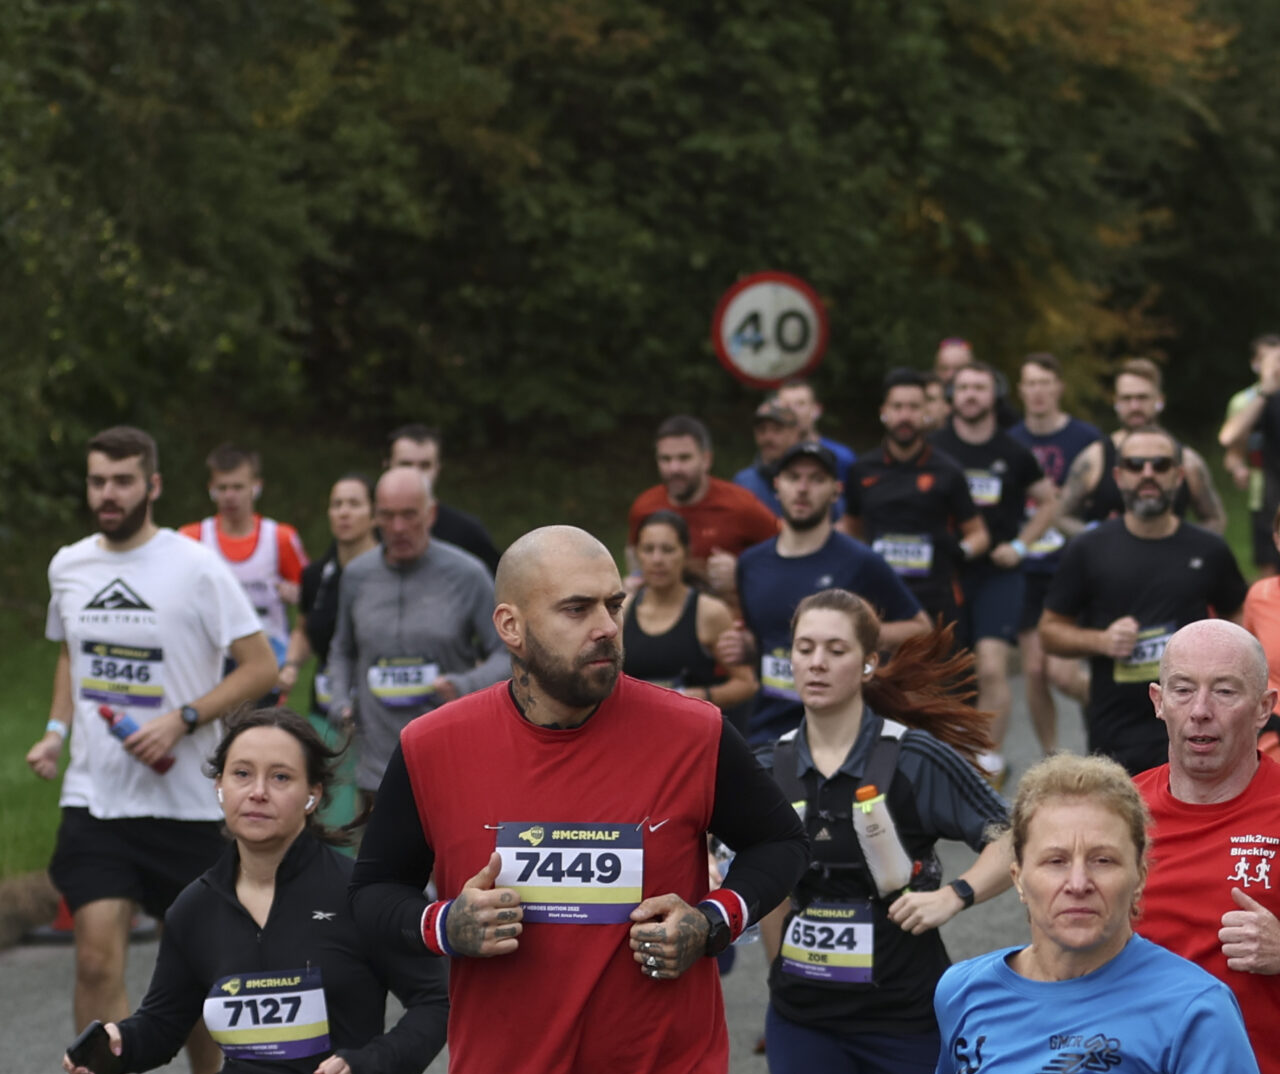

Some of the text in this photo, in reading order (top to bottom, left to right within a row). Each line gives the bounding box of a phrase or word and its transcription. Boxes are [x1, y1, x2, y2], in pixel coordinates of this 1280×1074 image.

[733, 309, 810, 354] 40
[90, 660, 151, 682] 5846
[552, 829, 620, 841] #MCRHALF
[1230, 834, 1280, 845] walk2run
[1230, 847, 1276, 859] Blackley
[515, 852, 622, 884] 7449
[791, 921, 857, 950] 6524
[808, 952, 828, 963] ZOE
[246, 976, 301, 989] #MCRHALF
[223, 996, 302, 1028] 7127
